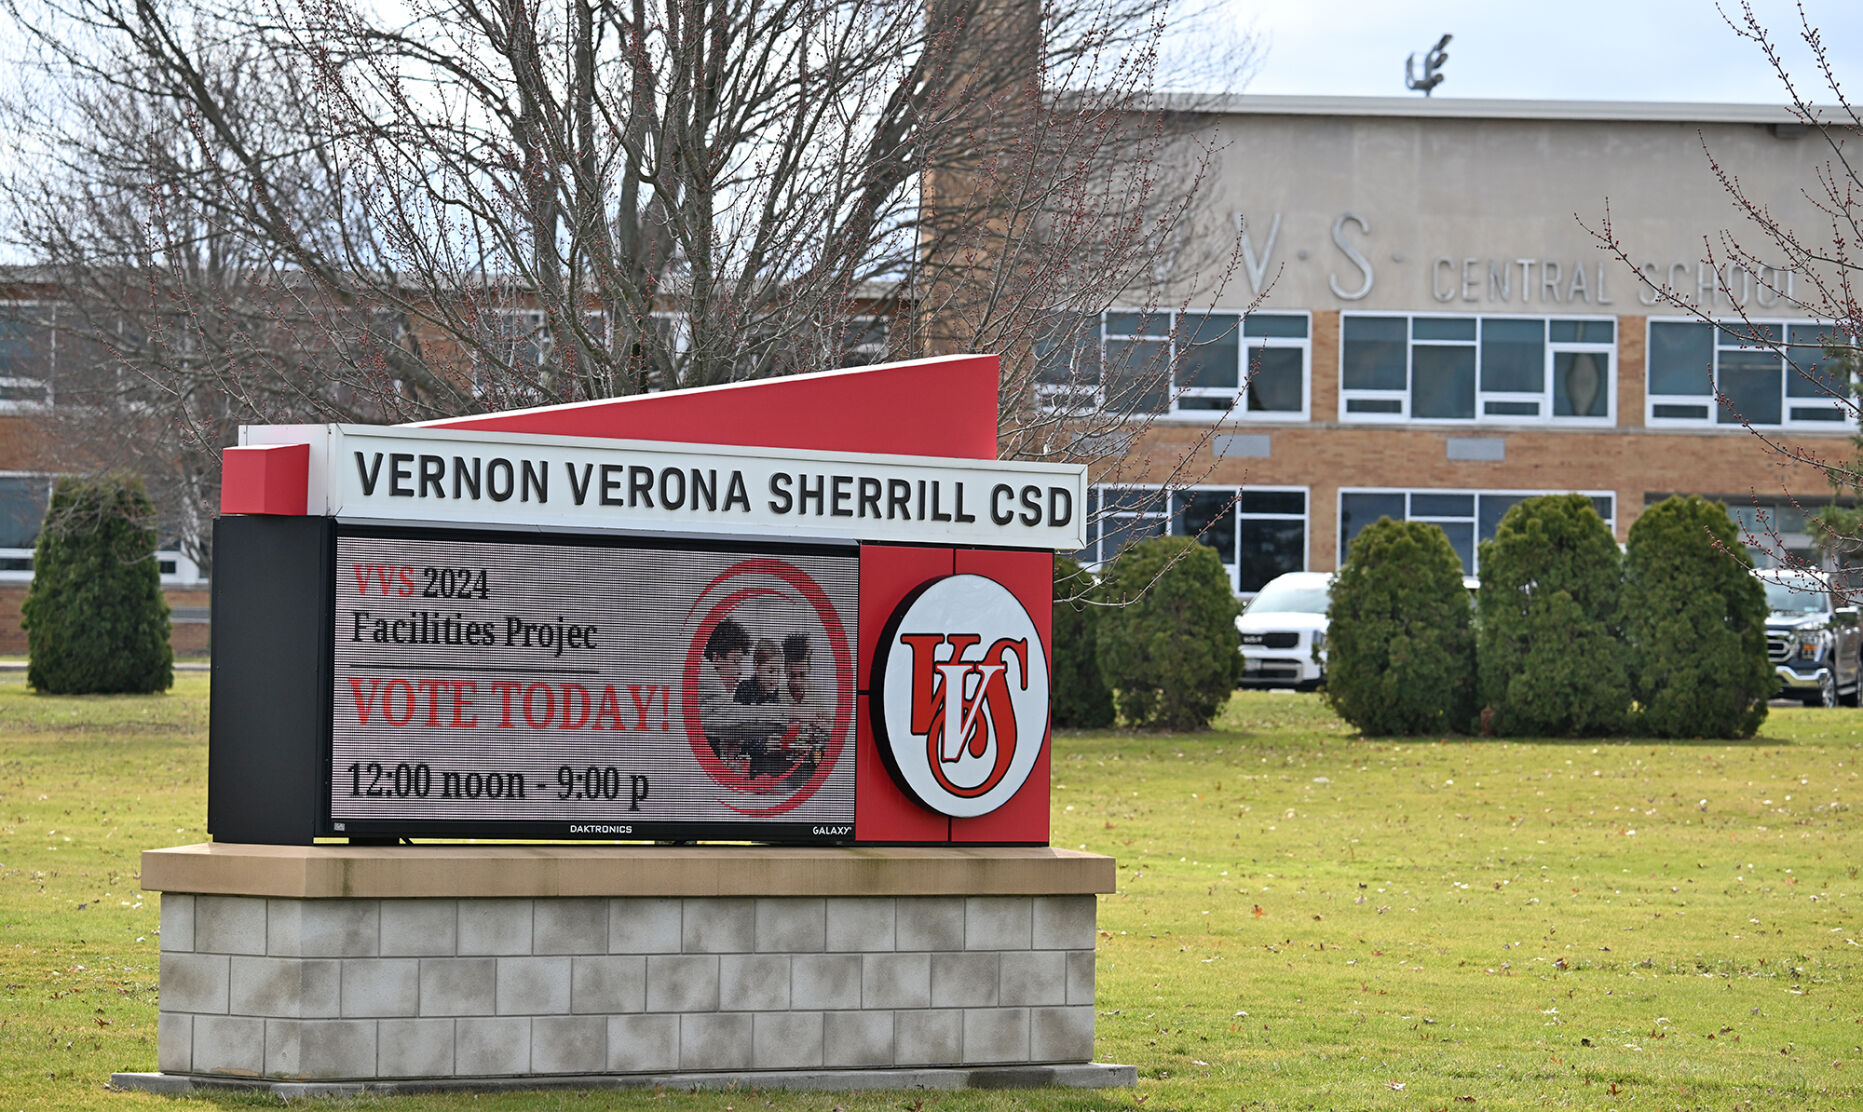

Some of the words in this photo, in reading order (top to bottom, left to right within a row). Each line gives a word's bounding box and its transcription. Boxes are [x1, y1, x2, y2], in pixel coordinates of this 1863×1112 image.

[1433, 256, 1615, 307] CENTRAL
[1639, 259, 1797, 308] SCHOOL
[354, 451, 549, 505] VERNON
[566, 462, 752, 514] VERONA
[769, 472, 977, 524] SHERRILL
[990, 483, 1073, 528] CSD
[352, 563, 415, 597] VVS
[423, 567, 490, 600] 2024
[351, 611, 495, 646] Facilities
[504, 615, 598, 658] Projec
[348, 677, 478, 727] VOTE
[491, 681, 671, 732] TODAY!
[347, 762, 431, 798] 12:00
[440, 771, 526, 799] noon
[557, 765, 620, 800] 9:00
[629, 773, 650, 812] p
[570, 825, 633, 834] DAKTRONICS
[812, 826, 851, 835] GALAXY
